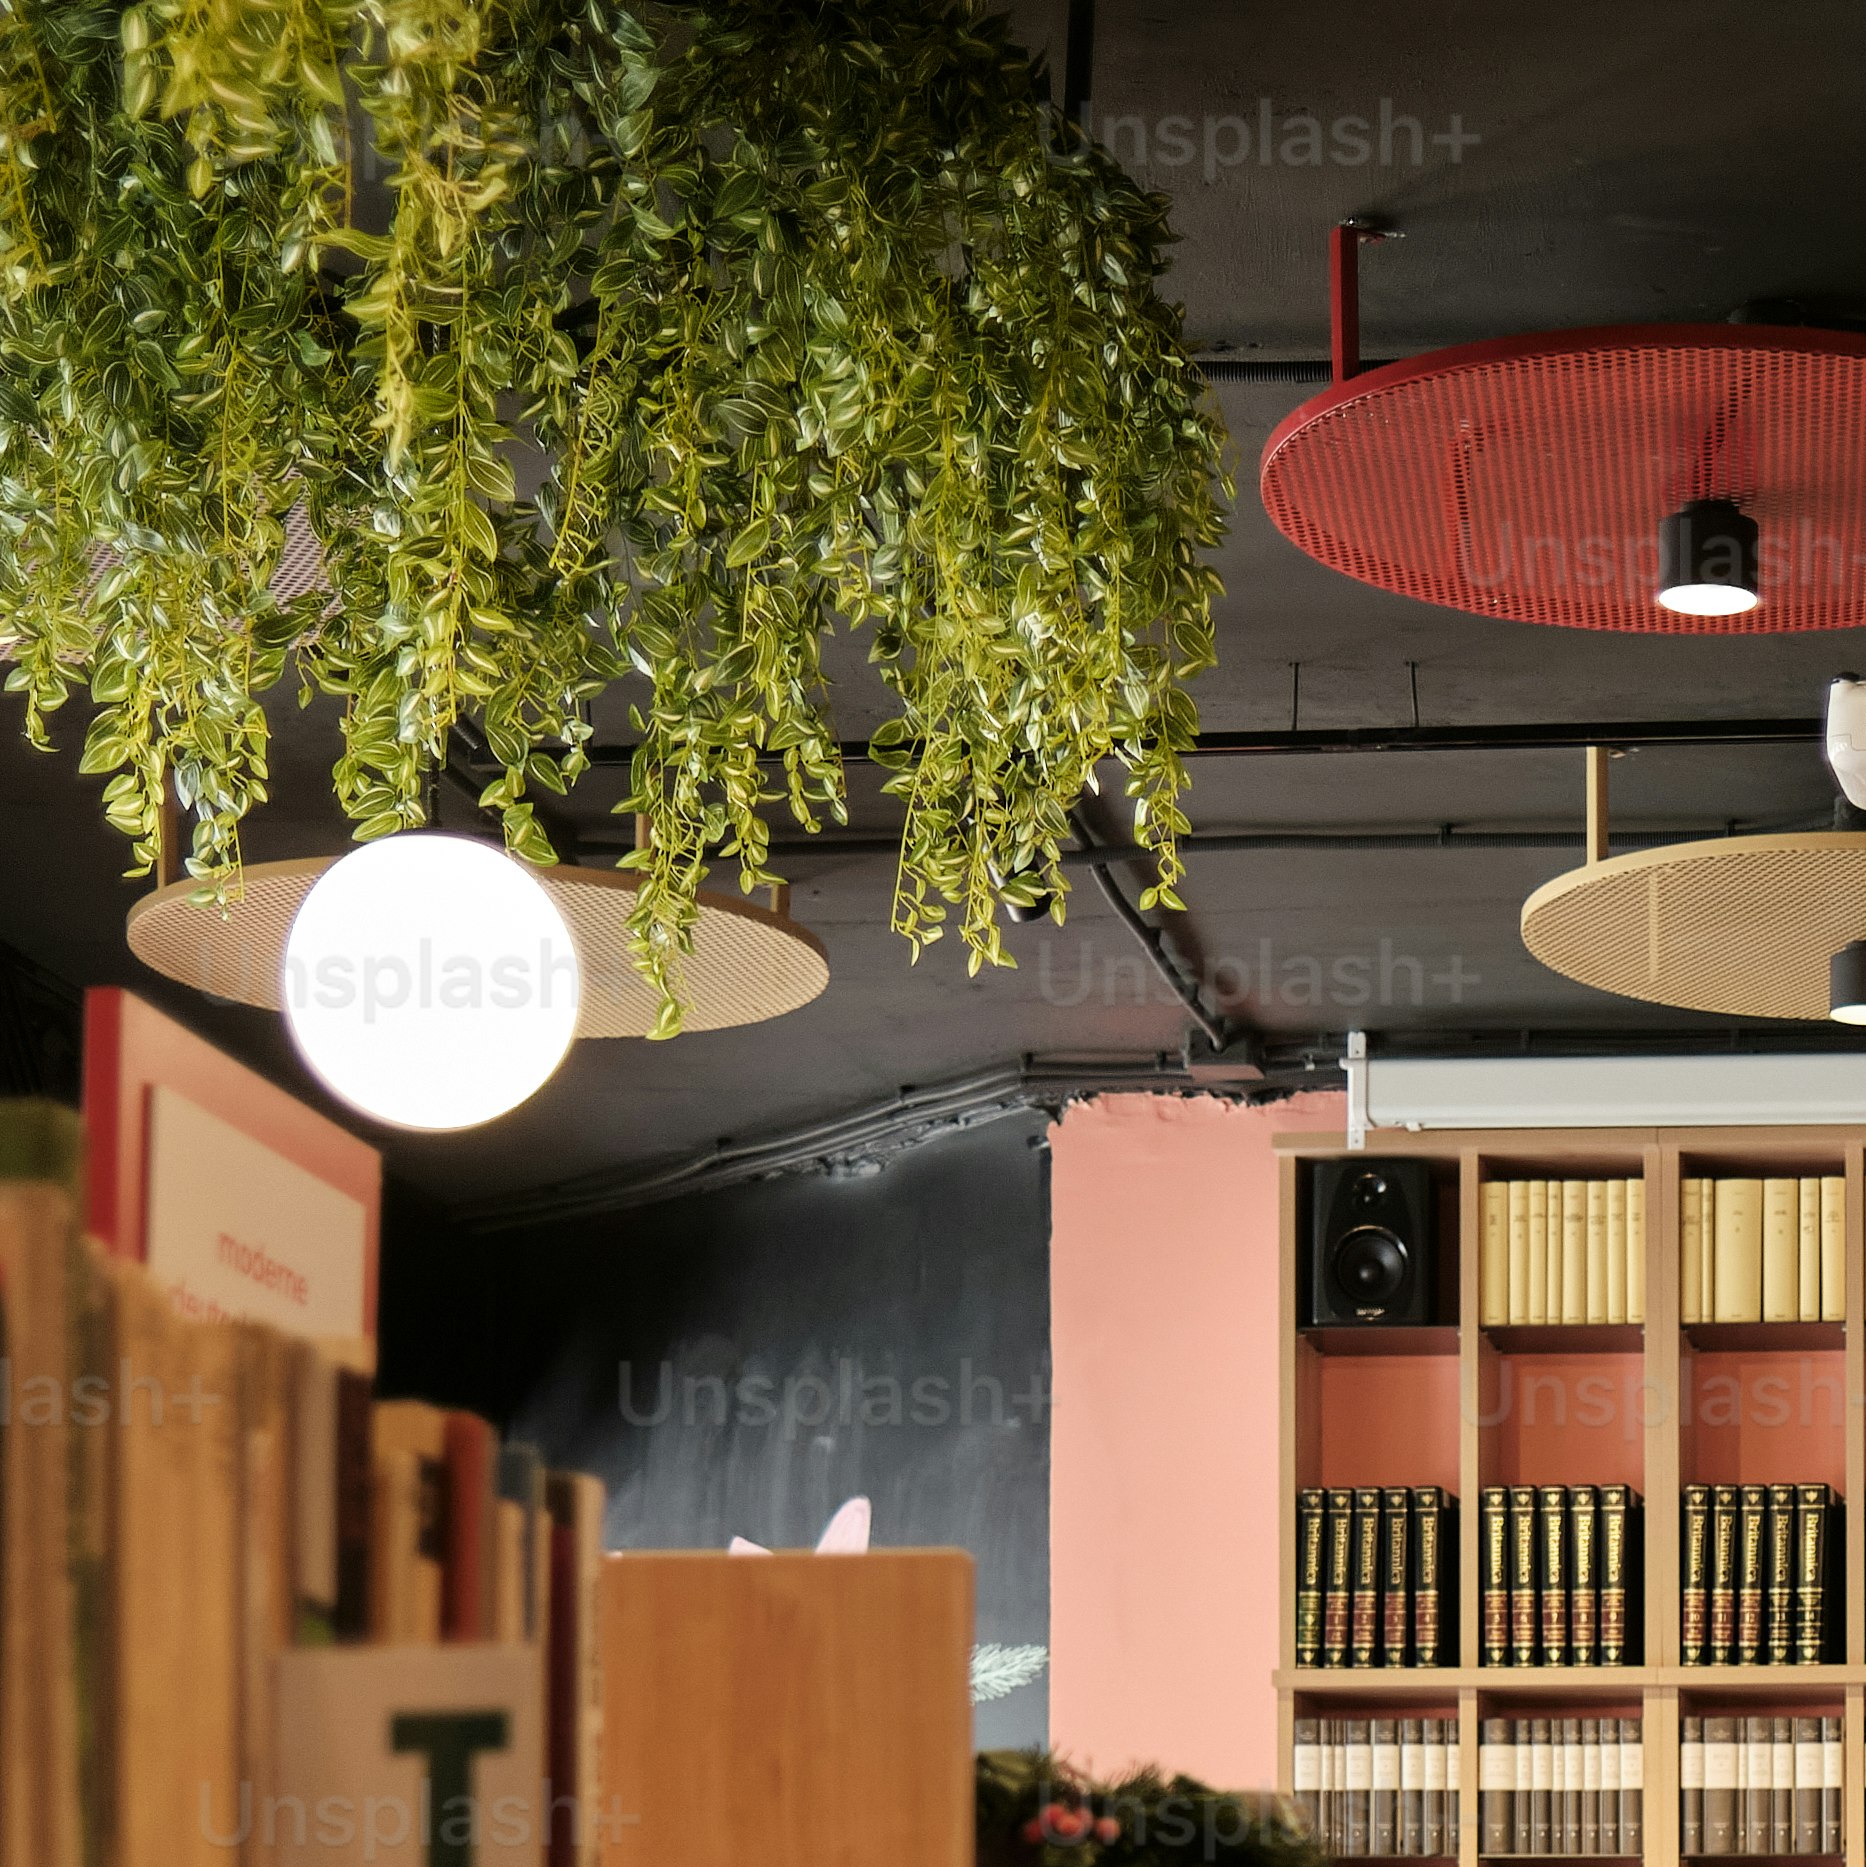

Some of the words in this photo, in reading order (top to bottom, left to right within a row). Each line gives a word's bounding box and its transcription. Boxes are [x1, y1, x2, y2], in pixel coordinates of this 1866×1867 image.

[1491, 1516, 1504, 1584] Britannica
[1518, 1516, 1531, 1584] Britannica
[1548, 1516, 1561, 1584] Britannica
[1577, 1516, 1591, 1583] Britannica
[1607, 1515, 1621, 1582] Britannica
[1690, 1515, 1704, 1583] Britannica
[1719, 1515, 1732, 1583] Britannica
[1746, 1515, 1760, 1582] Britannica
[1776, 1514, 1788, 1582] Britannica
[1805, 1514, 1818, 1582] Britannica
